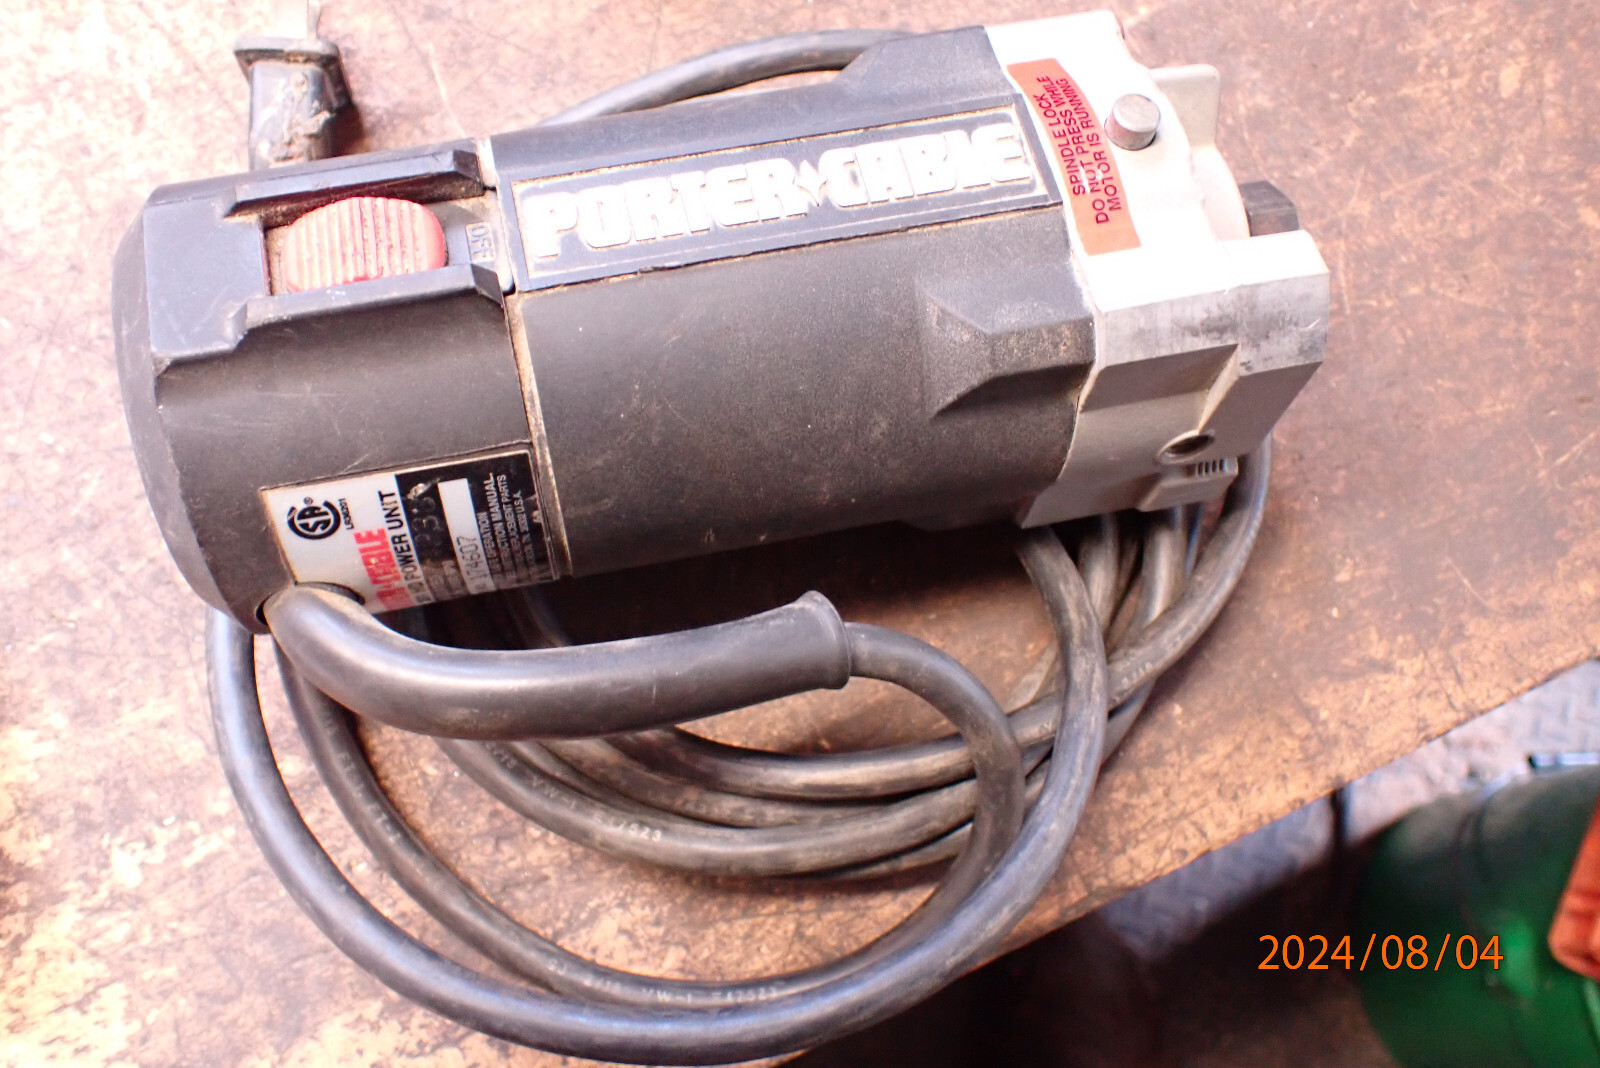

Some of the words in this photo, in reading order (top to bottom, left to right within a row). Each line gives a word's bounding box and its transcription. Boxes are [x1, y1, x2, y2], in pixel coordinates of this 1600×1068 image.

[1033, 93, 1059, 127] LOCK
[1036, 75, 1067, 107] WHILE
[1056, 78, 1095, 129] RUNNING
[1060, 109, 1089, 155] PRESS
[1087, 132, 1103, 147] IS
[1053, 129, 1086, 196] SPINDLE
[1080, 158, 1101, 193] NOT
[1093, 150, 1122, 212] MOTOR
[525, 157, 806, 259] PORTER
[819, 122, 1031, 208] CABLE
[1092, 198, 1110, 225] DO
[471, 225, 494, 258] OFF
[496, 474, 512, 504] PARTS
[378, 490, 404, 531] UNIT
[390, 533, 422, 581] POWER
